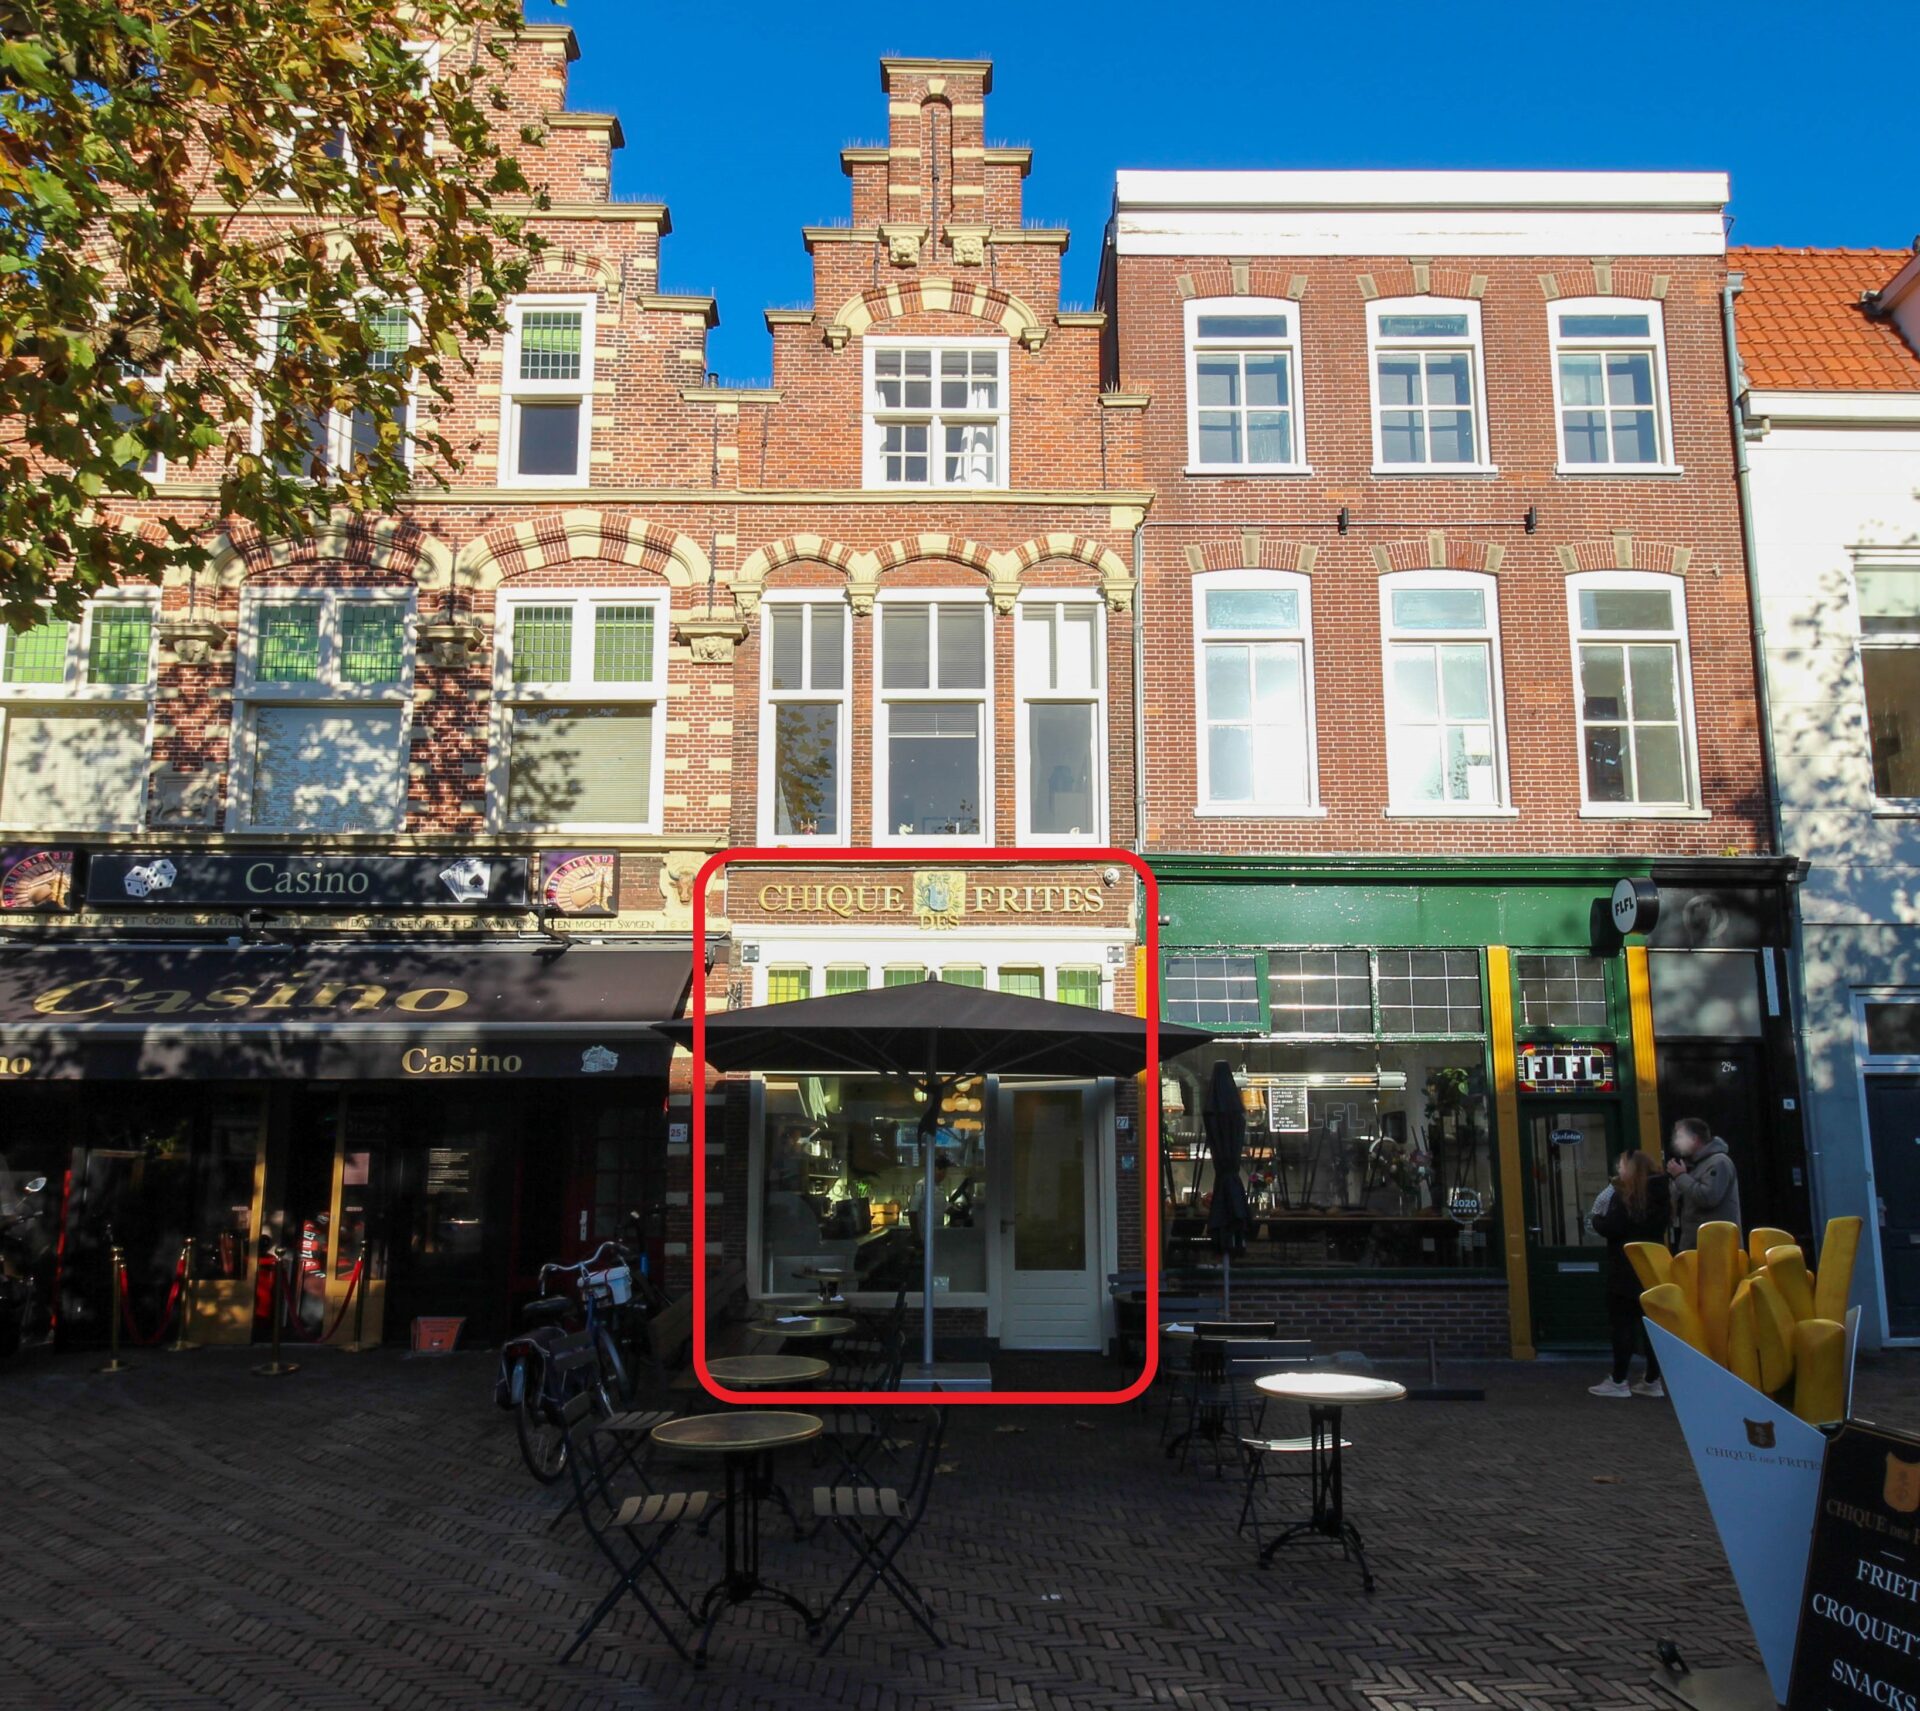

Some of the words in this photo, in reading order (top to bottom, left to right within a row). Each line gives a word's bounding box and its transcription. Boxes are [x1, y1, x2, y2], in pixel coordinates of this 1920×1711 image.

[245, 861, 370, 894] Casino
[758, 885, 905, 918] CHIQUE
[973, 885, 1105, 914] FRITES
[1615, 896, 1634, 916] FLFL
[576, 919, 613, 930] MOCHT
[919, 915, 960, 931] DES
[33, 971, 469, 1015] Casino
[401, 1046, 523, 1075] Casino
[1527, 1055, 1602, 1080] FLFL
[1453, 1199, 1477, 1208] 2020
[1705, 1446, 1758, 1463] CHIQUE
[1826, 1499, 1888, 1533] CHIQUE
